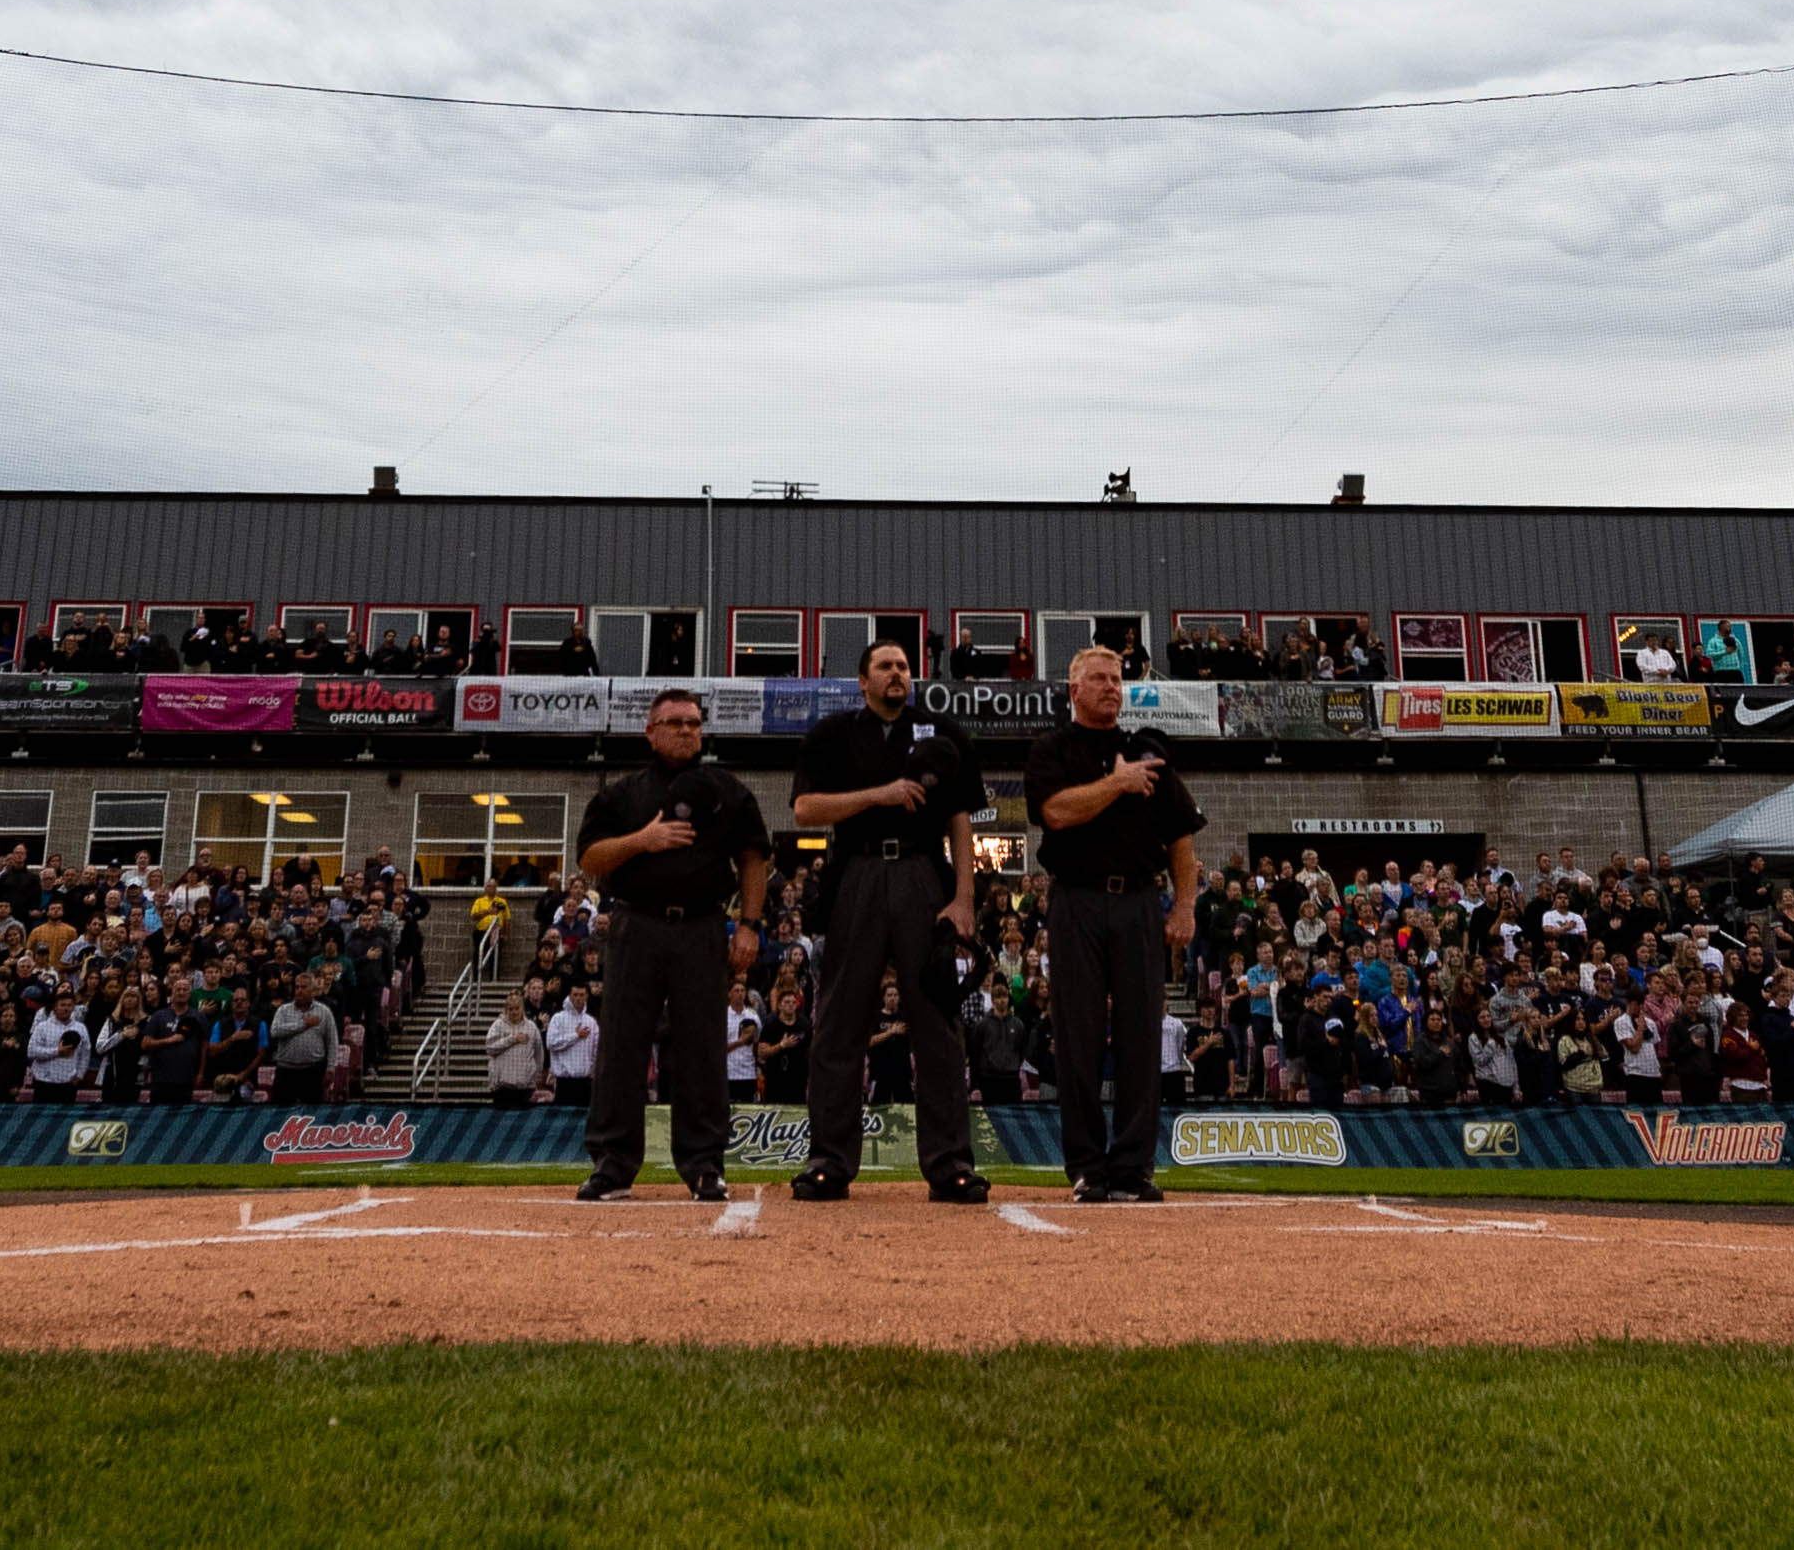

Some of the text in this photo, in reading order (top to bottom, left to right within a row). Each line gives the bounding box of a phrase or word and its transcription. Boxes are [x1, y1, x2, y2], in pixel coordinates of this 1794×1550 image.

[315, 681, 435, 712] Wilson
[508, 694, 600, 711] TOYOTA
[925, 683, 1055, 715] OnPoint
[1327, 693, 1362, 705] ARMY
[1616, 689, 1701, 703] Black Bear
[1402, 691, 1441, 718] Tires
[1446, 699, 1544, 715] LES SCHWAB
[329, 713, 418, 725] OFFICIAL BALL
[1151, 711, 1209, 721] AUTOMATION
[1328, 710, 1364, 721] GUARD
[1642, 707, 1683, 721] Diner
[1568, 725, 1708, 735] FEED YOUR INNER BEAR
[1320, 821, 1417, 832] RESTROOMS
[264, 1112, 415, 1152] Mavericks
[1179, 1121, 1338, 1156] SENATORS
[1625, 1112, 1785, 1164] VOLCANOES
